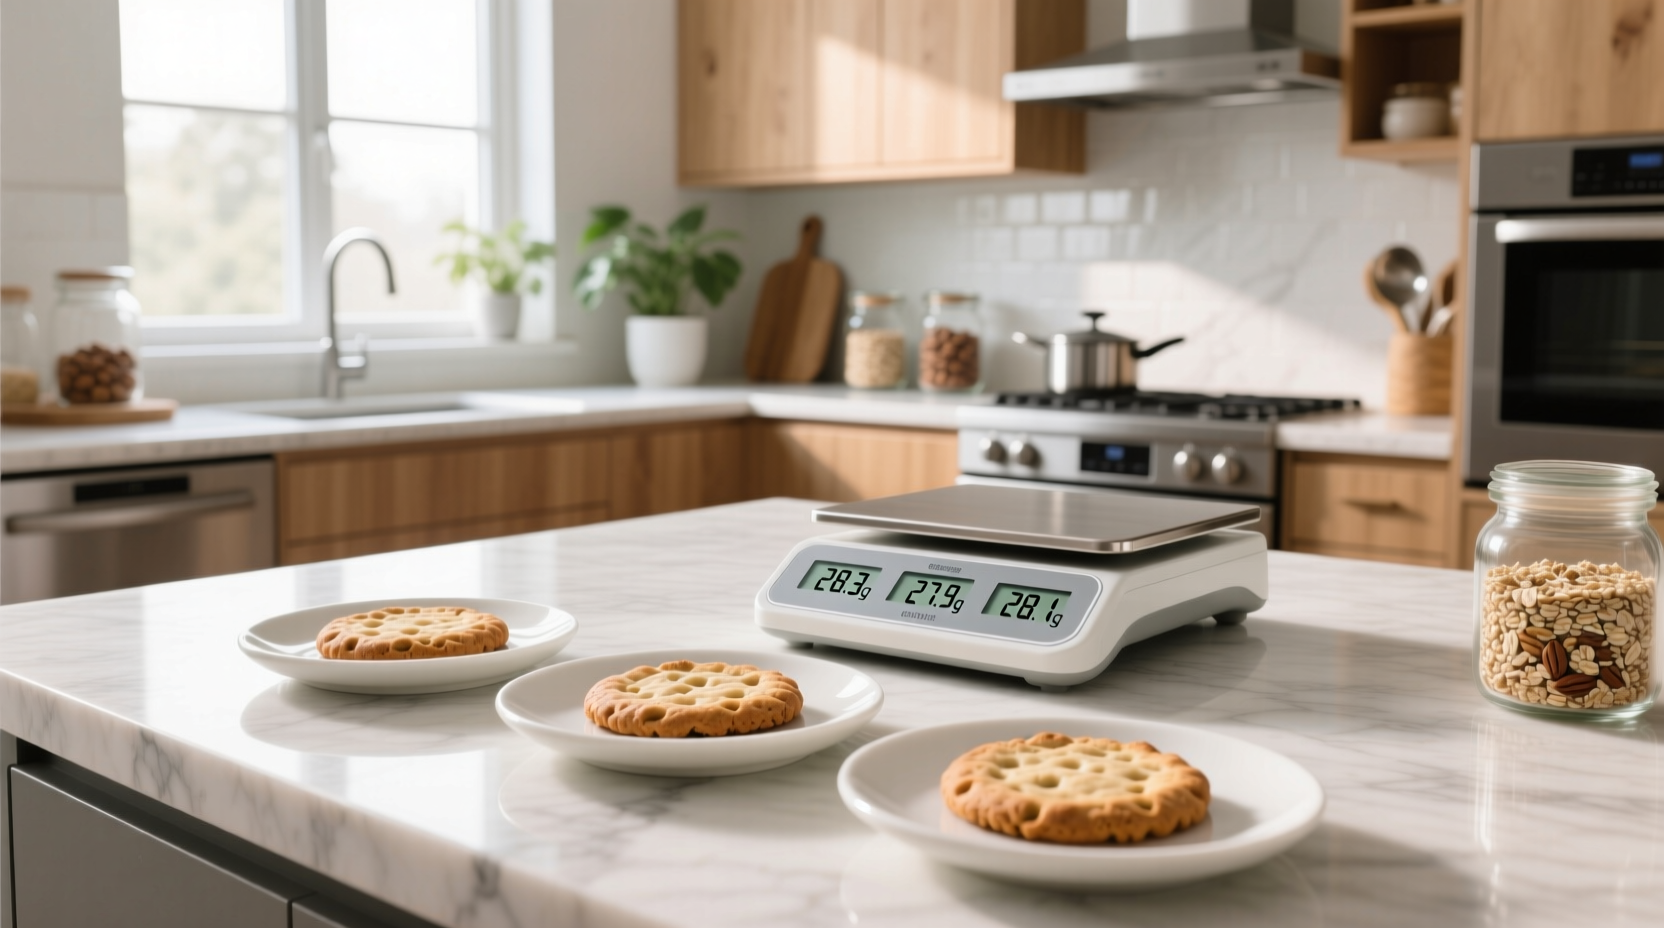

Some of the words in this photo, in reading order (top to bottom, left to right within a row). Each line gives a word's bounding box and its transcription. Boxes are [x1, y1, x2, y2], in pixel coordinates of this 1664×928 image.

[814, 568, 872, 600] 28.3g
[905, 580, 964, 614] 27.9g
[1000, 592, 1063, 628] 28.1g
